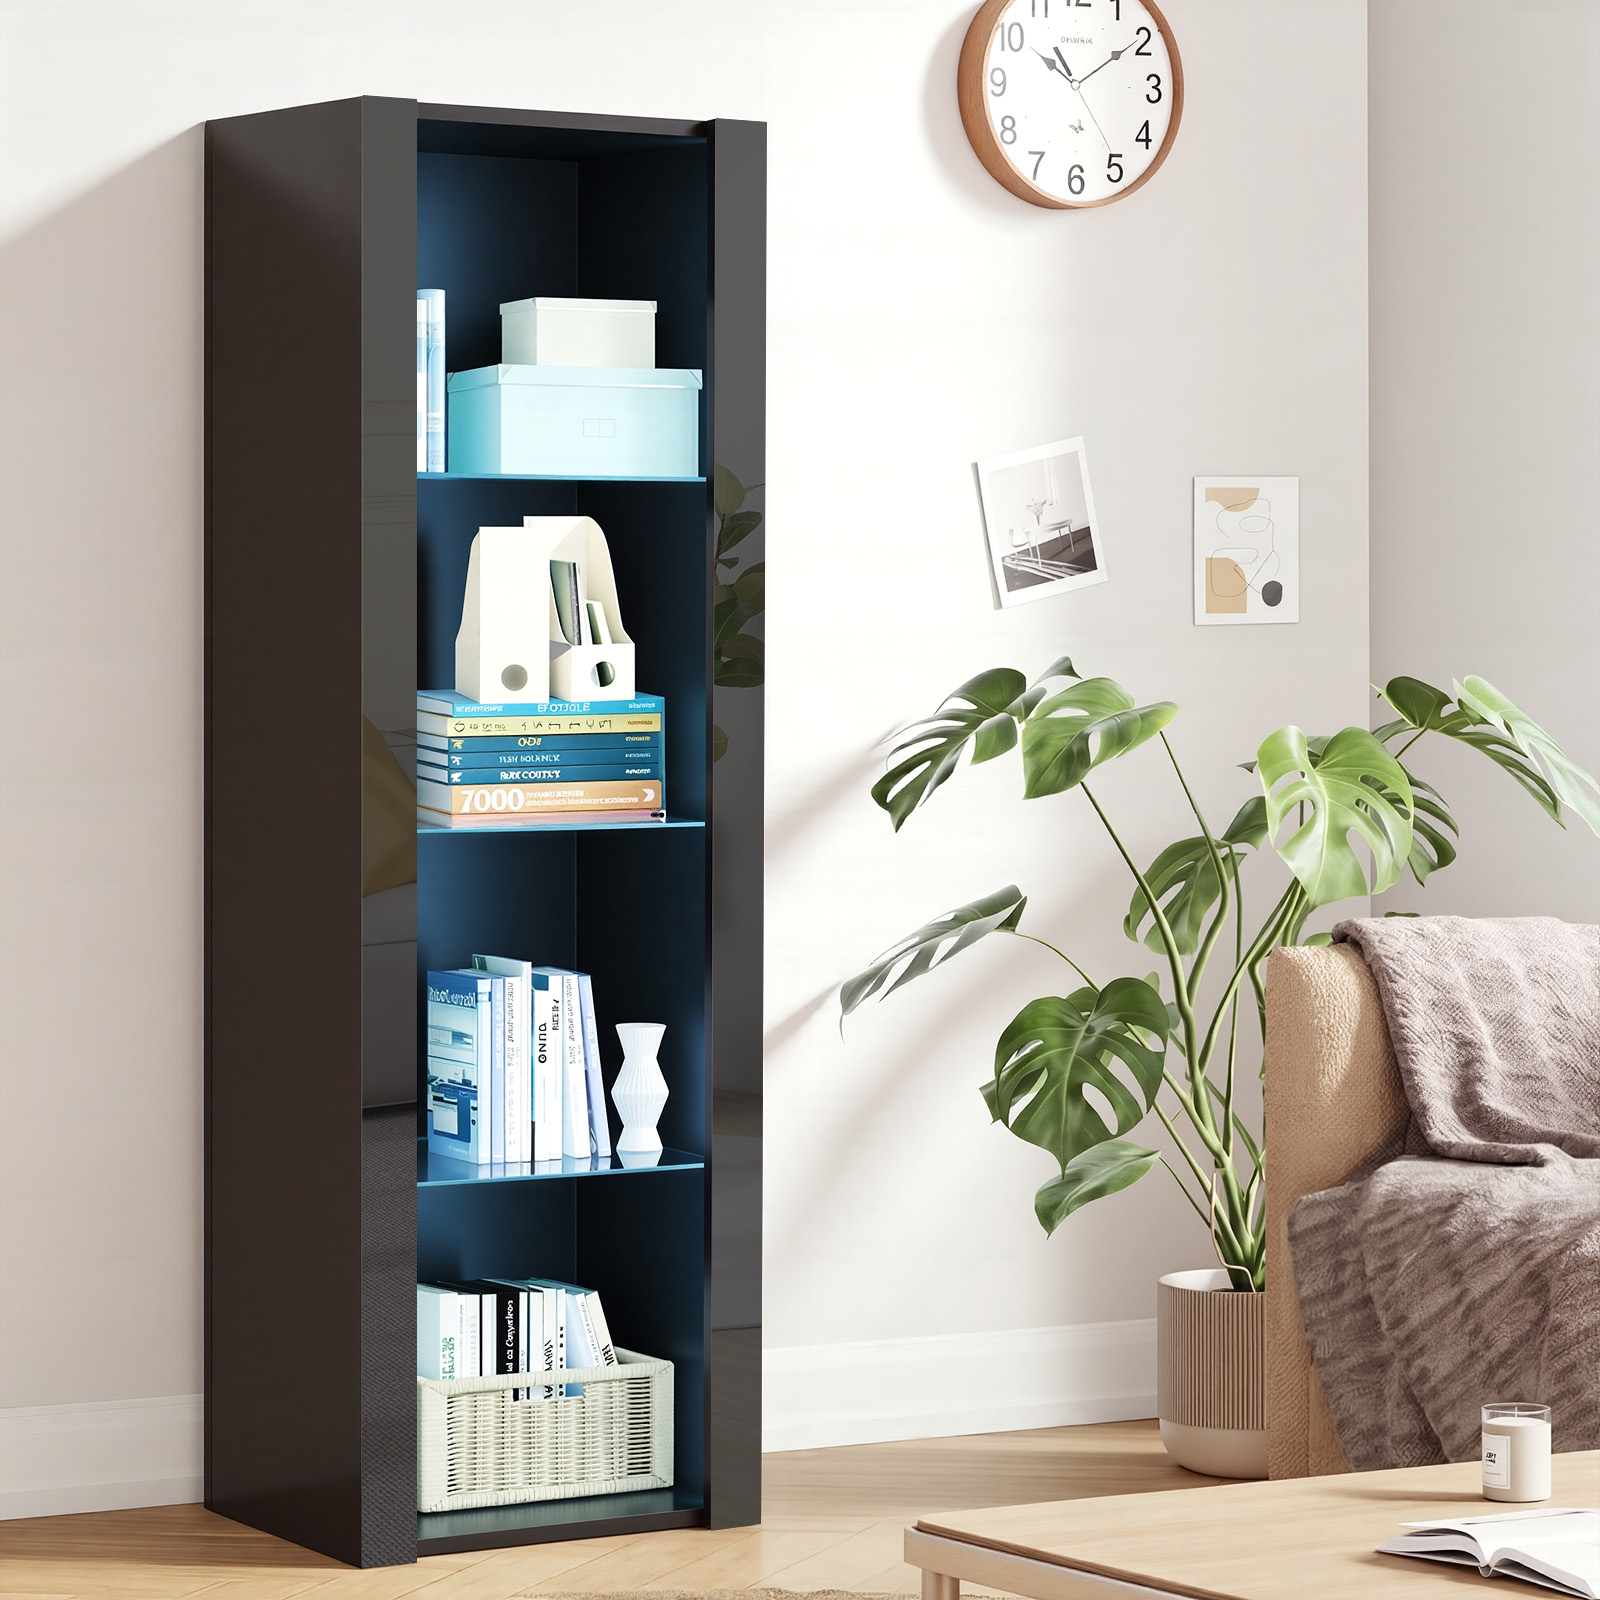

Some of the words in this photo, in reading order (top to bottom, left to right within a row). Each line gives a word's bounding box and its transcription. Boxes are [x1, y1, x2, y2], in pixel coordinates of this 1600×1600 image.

[998, 22, 1024, 52] 10
[1135, 26, 1152, 56] 2
[990, 67, 1007, 97] 9
[1145, 73, 1162, 104] 3
[1000, 115, 1017, 145] 8
[1135, 119, 1152, 150] 4
[1028, 151, 1045, 181] 7
[1067, 164, 1085, 195] 6
[1106, 153, 1124, 183] 5
[460, 788, 525, 814] 7000
